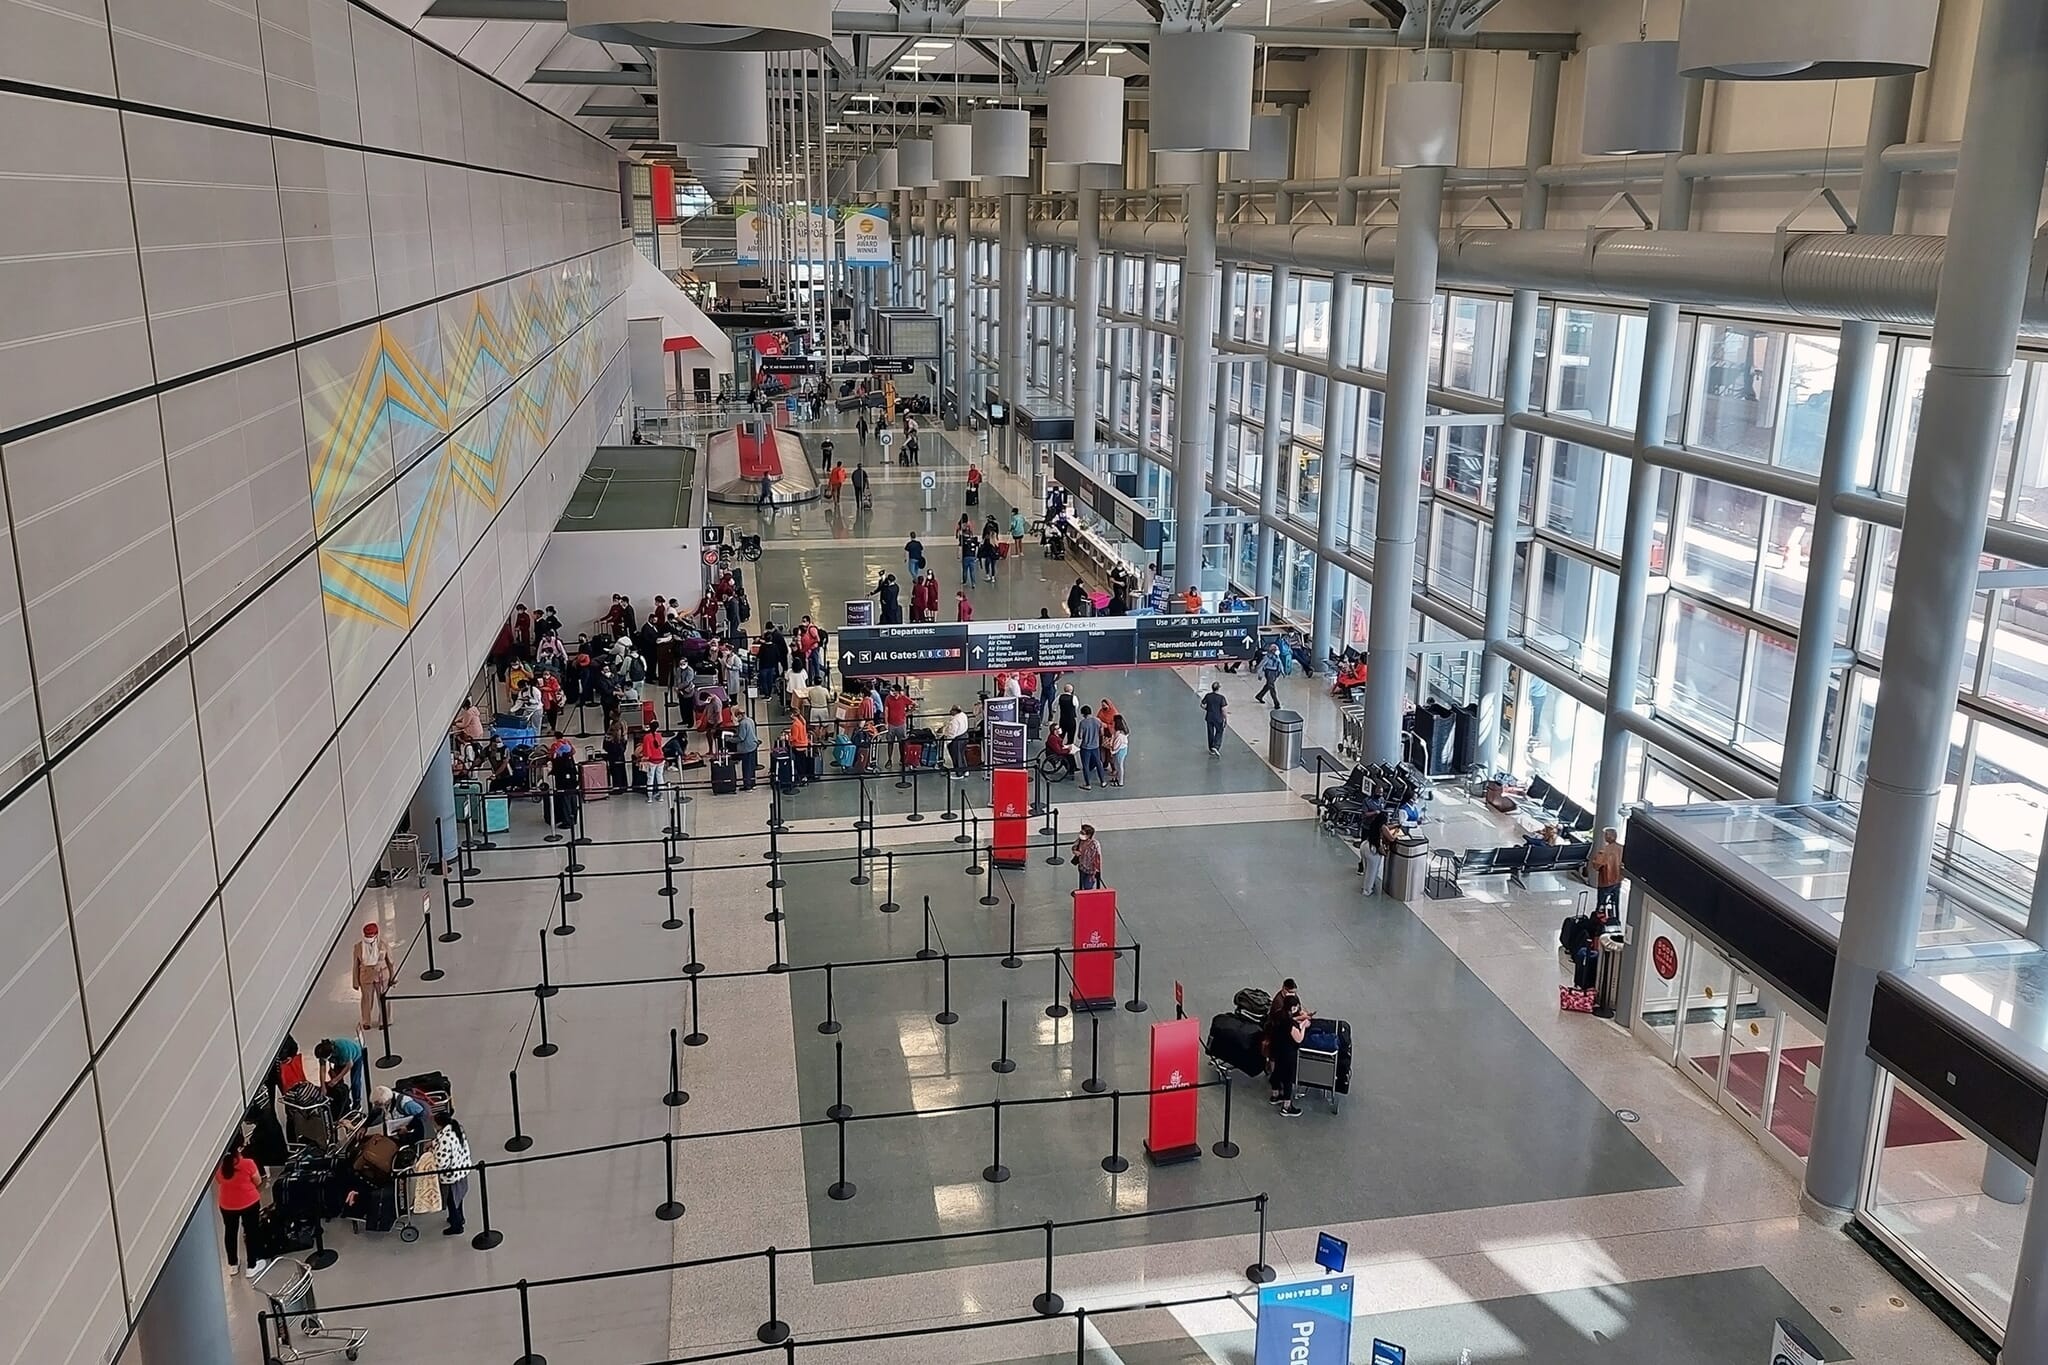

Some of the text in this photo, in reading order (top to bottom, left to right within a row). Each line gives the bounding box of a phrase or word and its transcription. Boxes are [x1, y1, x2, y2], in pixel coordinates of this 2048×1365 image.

[856, 233, 878, 241] Skytrax
[1027, 622, 1096, 631] Ticketing/Check-In
[890, 628, 935, 636] Departures:
[1199, 630, 1224, 638] Parking
[1157, 639, 1224, 648] International Arrivals
[874, 652, 888, 660] All
[890, 650, 917, 660] Gates
[1159, 651, 1184, 659] Subway
[996, 656, 1014, 664] Nippon
[993, 739, 1014, 747] Check-in
[1277, 1288, 1321, 1300] UNITED
